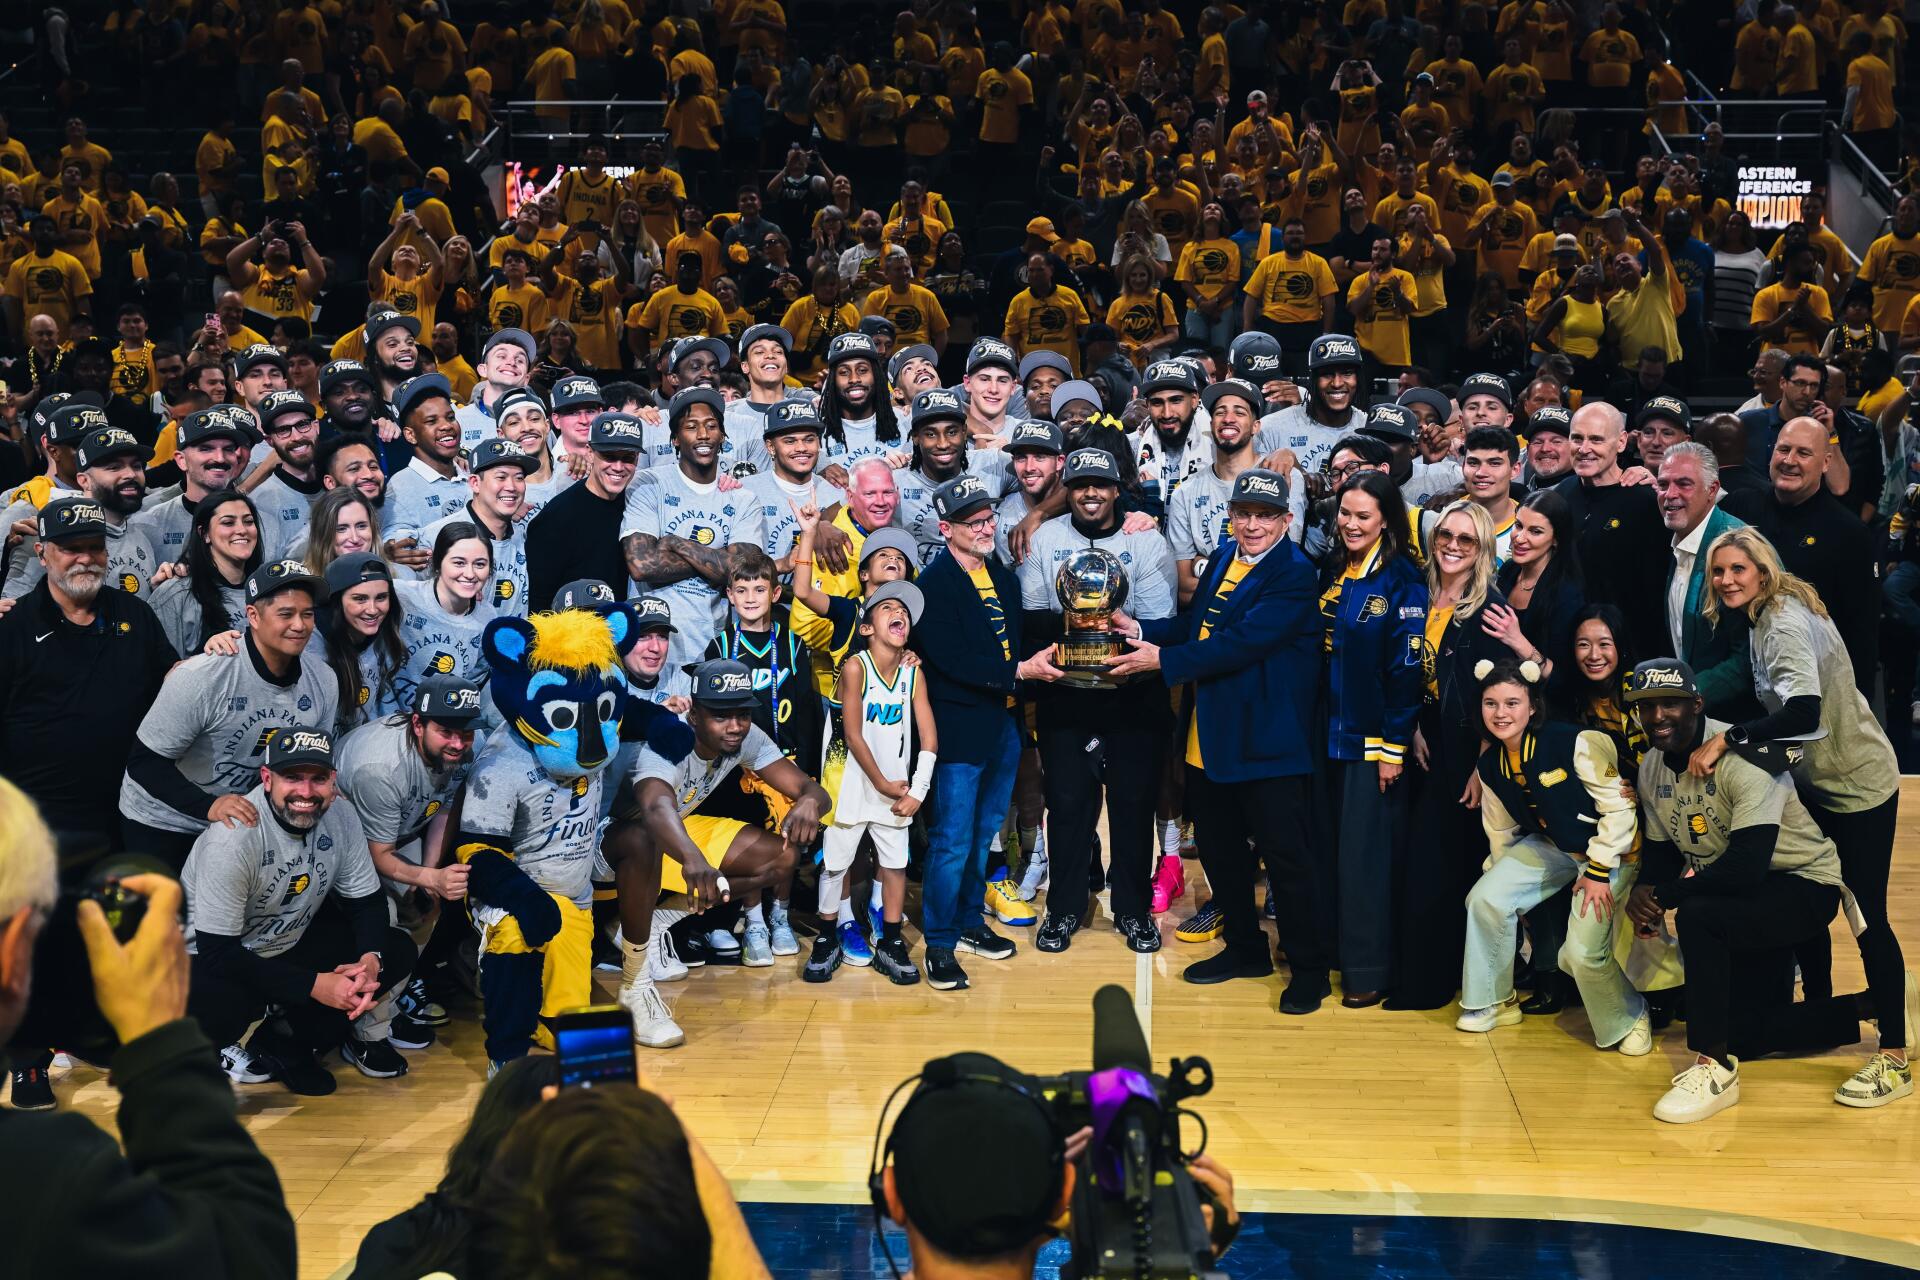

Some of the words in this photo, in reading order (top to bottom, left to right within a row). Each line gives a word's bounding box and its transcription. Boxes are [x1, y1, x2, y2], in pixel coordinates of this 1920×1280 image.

[1737, 195, 1803, 227] MPION
[249, 344, 280, 359] Finals
[840, 336, 871, 353] Finals
[982, 343, 1012, 359] Finals
[1322, 340, 1355, 359] Finals
[1152, 363, 1187, 381] Finals
[1248, 355, 1279, 371] Finals
[568, 381, 598, 397] Finals
[1476, 374, 1505, 389] Finals
[271, 391, 304, 410] Finals
[926, 392, 958, 410] Finals
[1653, 396, 1682, 413] Finals
[206, 412, 236, 430] Finals
[228, 407, 255, 425] Finals
[785, 403, 815, 420] Finals
[1370, 407, 1405, 427] Finals
[1535, 408, 1570, 423] Finals
[609, 420, 640, 438] Finals
[1018, 423, 1051, 440] Finals
[843, 446, 870, 468] IANA
[1075, 452, 1110, 471] Finals
[1301, 443, 1332, 469] DIANA
[1242, 476, 1280, 496] Finals
[68, 504, 105, 525] Finals
[665, 510, 704, 535] DIANA
[914, 503, 935, 538] INDIA
[1202, 502, 1226, 545] INDIAN
[768, 515, 795, 555] INDIAN
[638, 599, 669, 618] Finals
[718, 674, 751, 692] Finals
[1641, 668, 1683, 689] Finals
[778, 699, 792, 723] 0
[866, 702, 903, 725] IND
[224, 708, 276, 756] INDIANA
[288, 732, 330, 753] Finals
[542, 787, 557, 822] INDI
[1697, 795, 1729, 839] PCER
[256, 856, 303, 910] INDIANA
[241, 904, 312, 937] Finals
